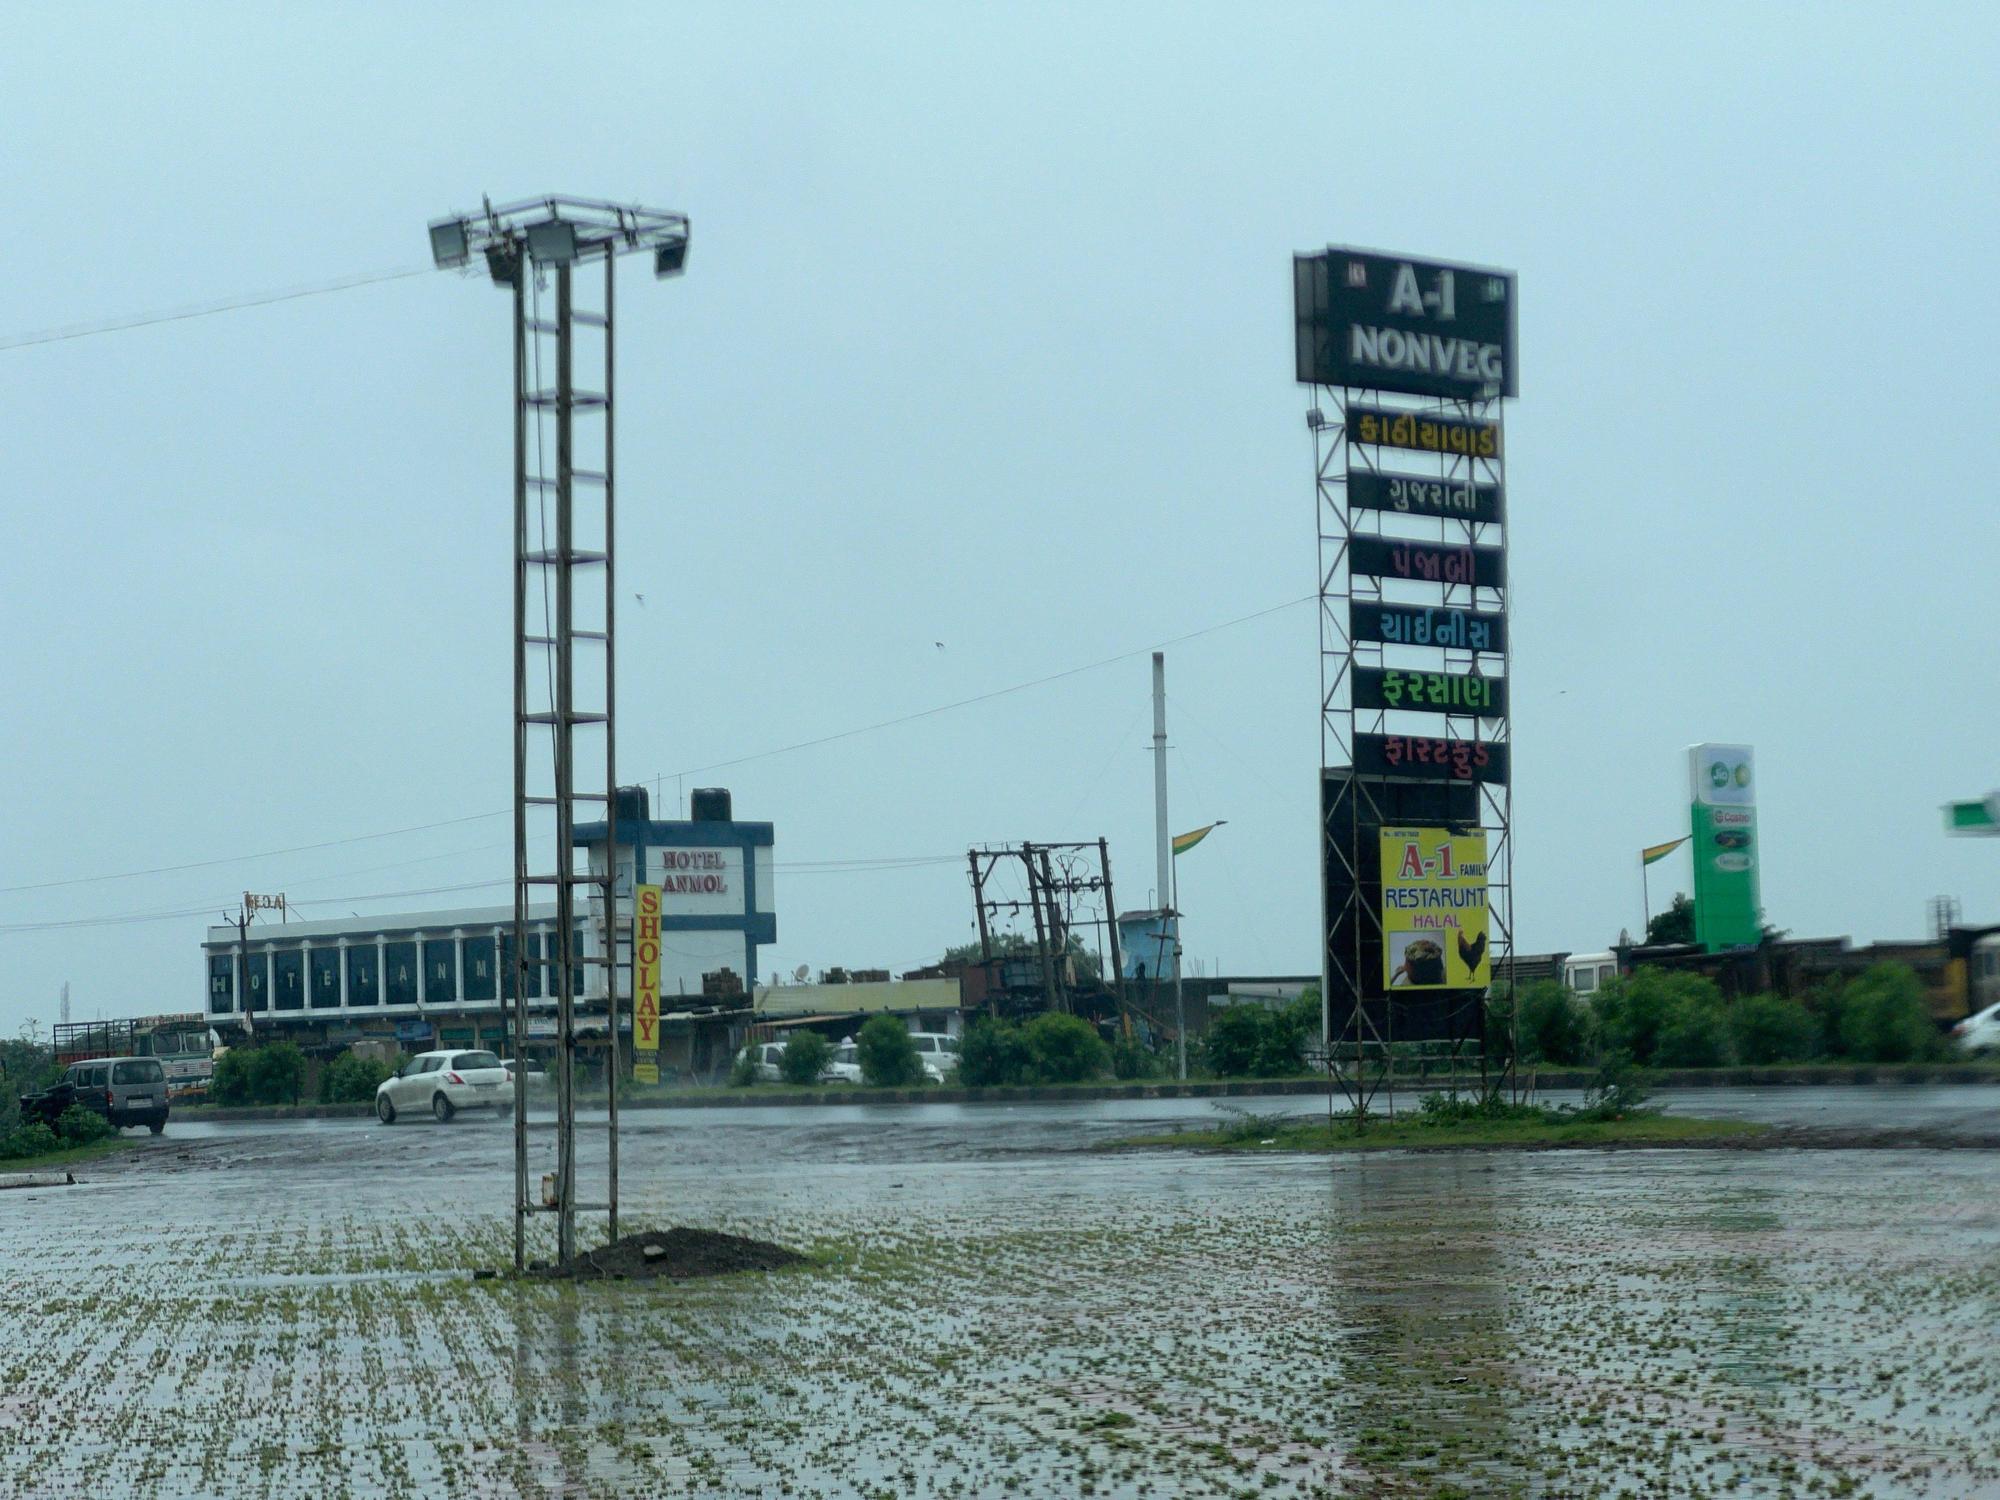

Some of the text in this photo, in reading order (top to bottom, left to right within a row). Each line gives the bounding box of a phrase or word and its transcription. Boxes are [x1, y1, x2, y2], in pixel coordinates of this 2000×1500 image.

[1351, 322, 1502, 383] NONVEG
[1388, 477, 1476, 512] ગુજરાતી
[1382, 671, 1490, 708] ફરસાણ
[663, 850, 727, 869] HOTEL
[1398, 841, 1487, 881] A-1 FAMILY
[662, 874, 728, 893] ANMOL
[1385, 887, 1487, 909] RESTARUNT
[1413, 914, 1461, 929] HALAL
[638, 891, 659, 1041] SHOLAY
